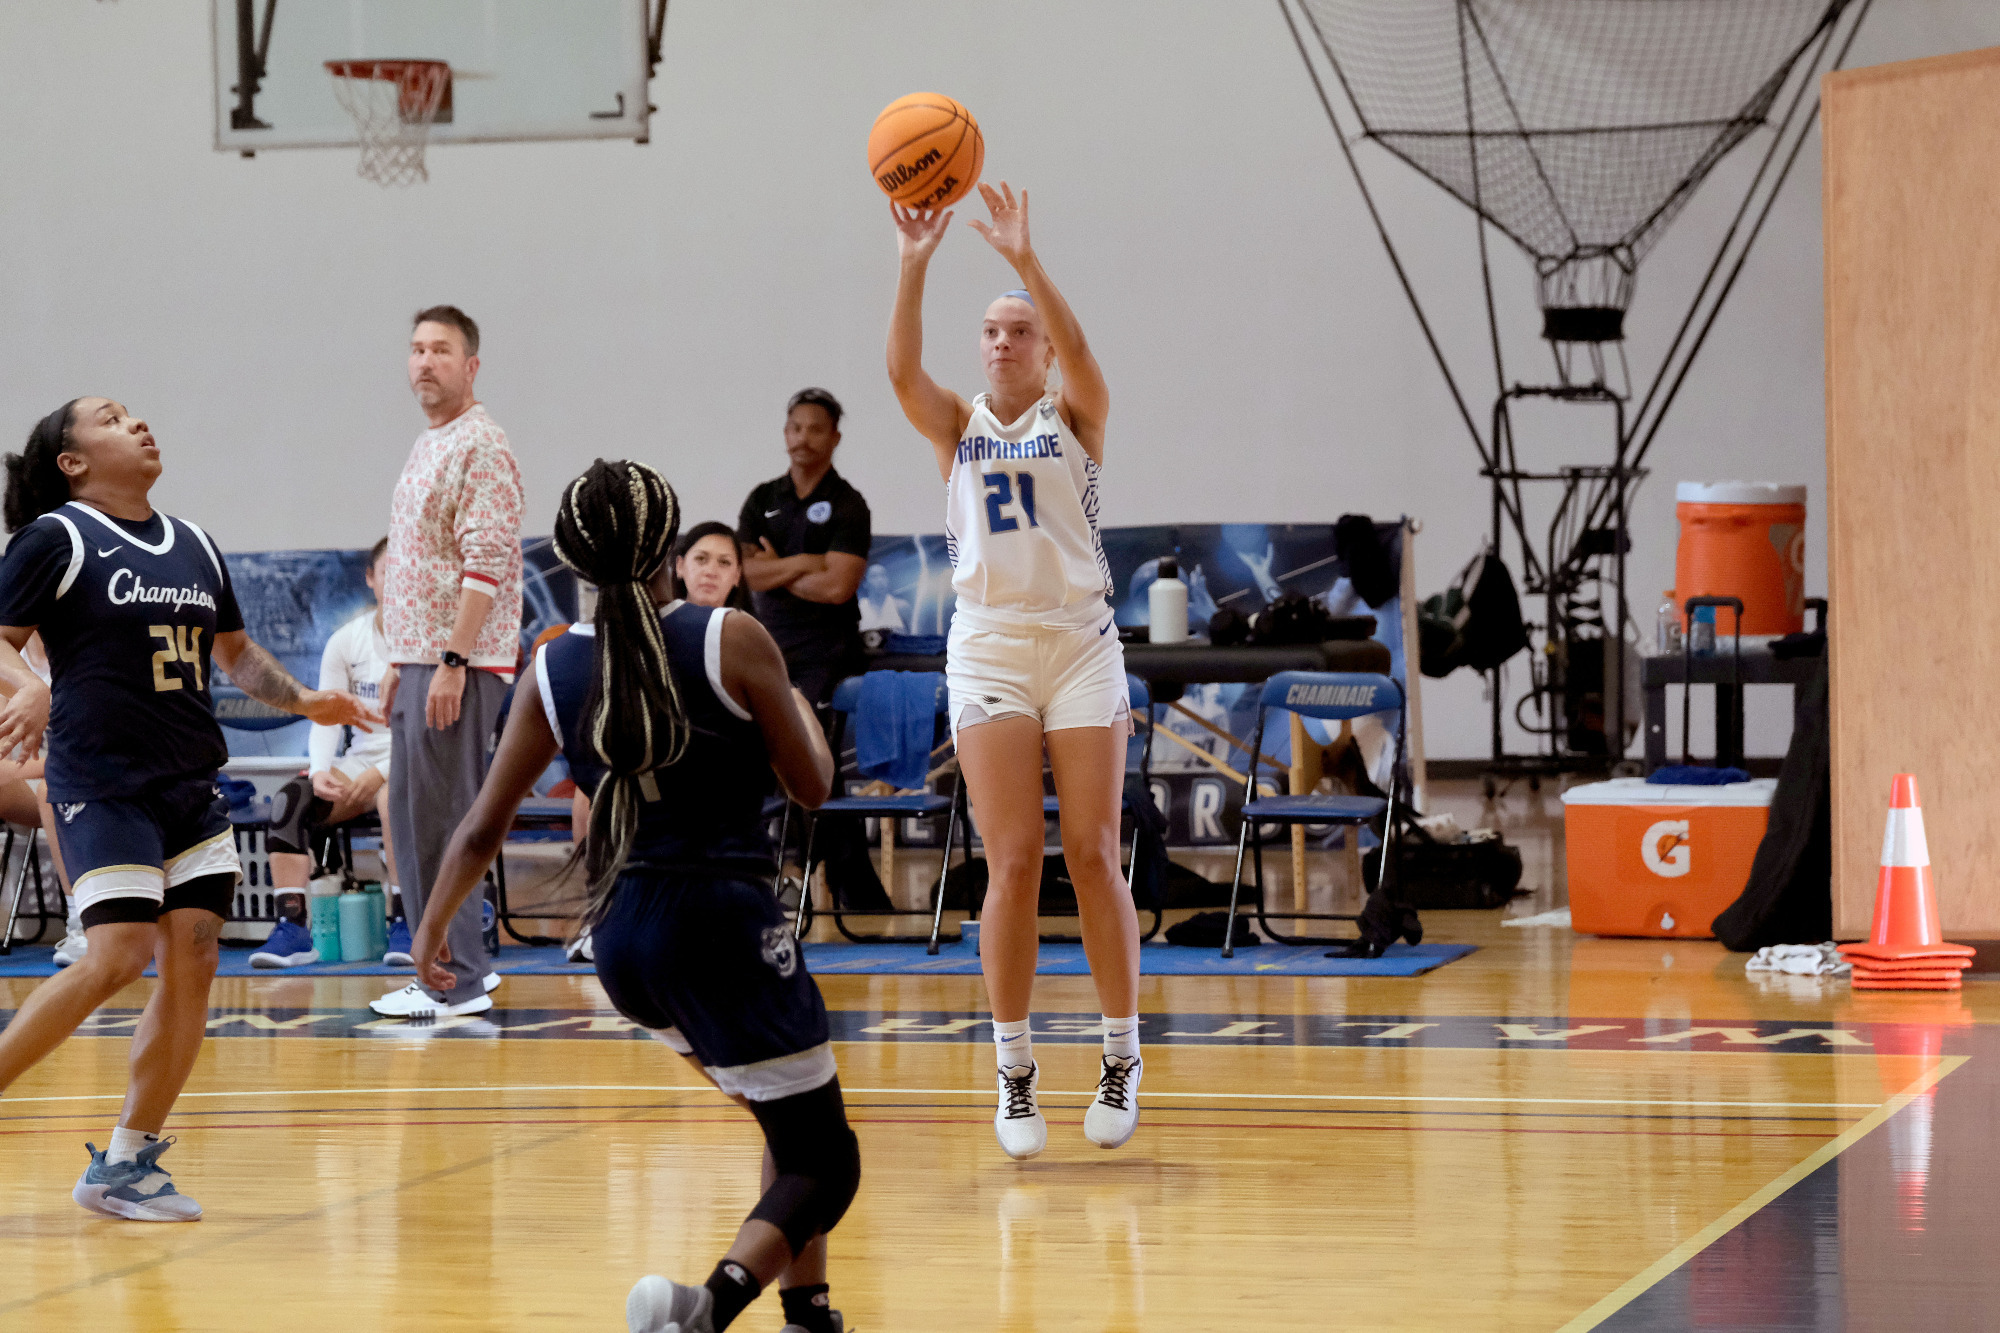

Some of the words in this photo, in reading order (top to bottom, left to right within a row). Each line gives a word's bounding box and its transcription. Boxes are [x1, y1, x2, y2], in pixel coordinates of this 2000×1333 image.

[878, 148, 942, 192] Wilson
[981, 471, 1039, 535] 21
[108, 568, 216, 612] Champion
[149, 625, 203, 691] 24
[1285, 683, 1377, 706] CHAMINADE
[1641, 819, 1691, 877] G
